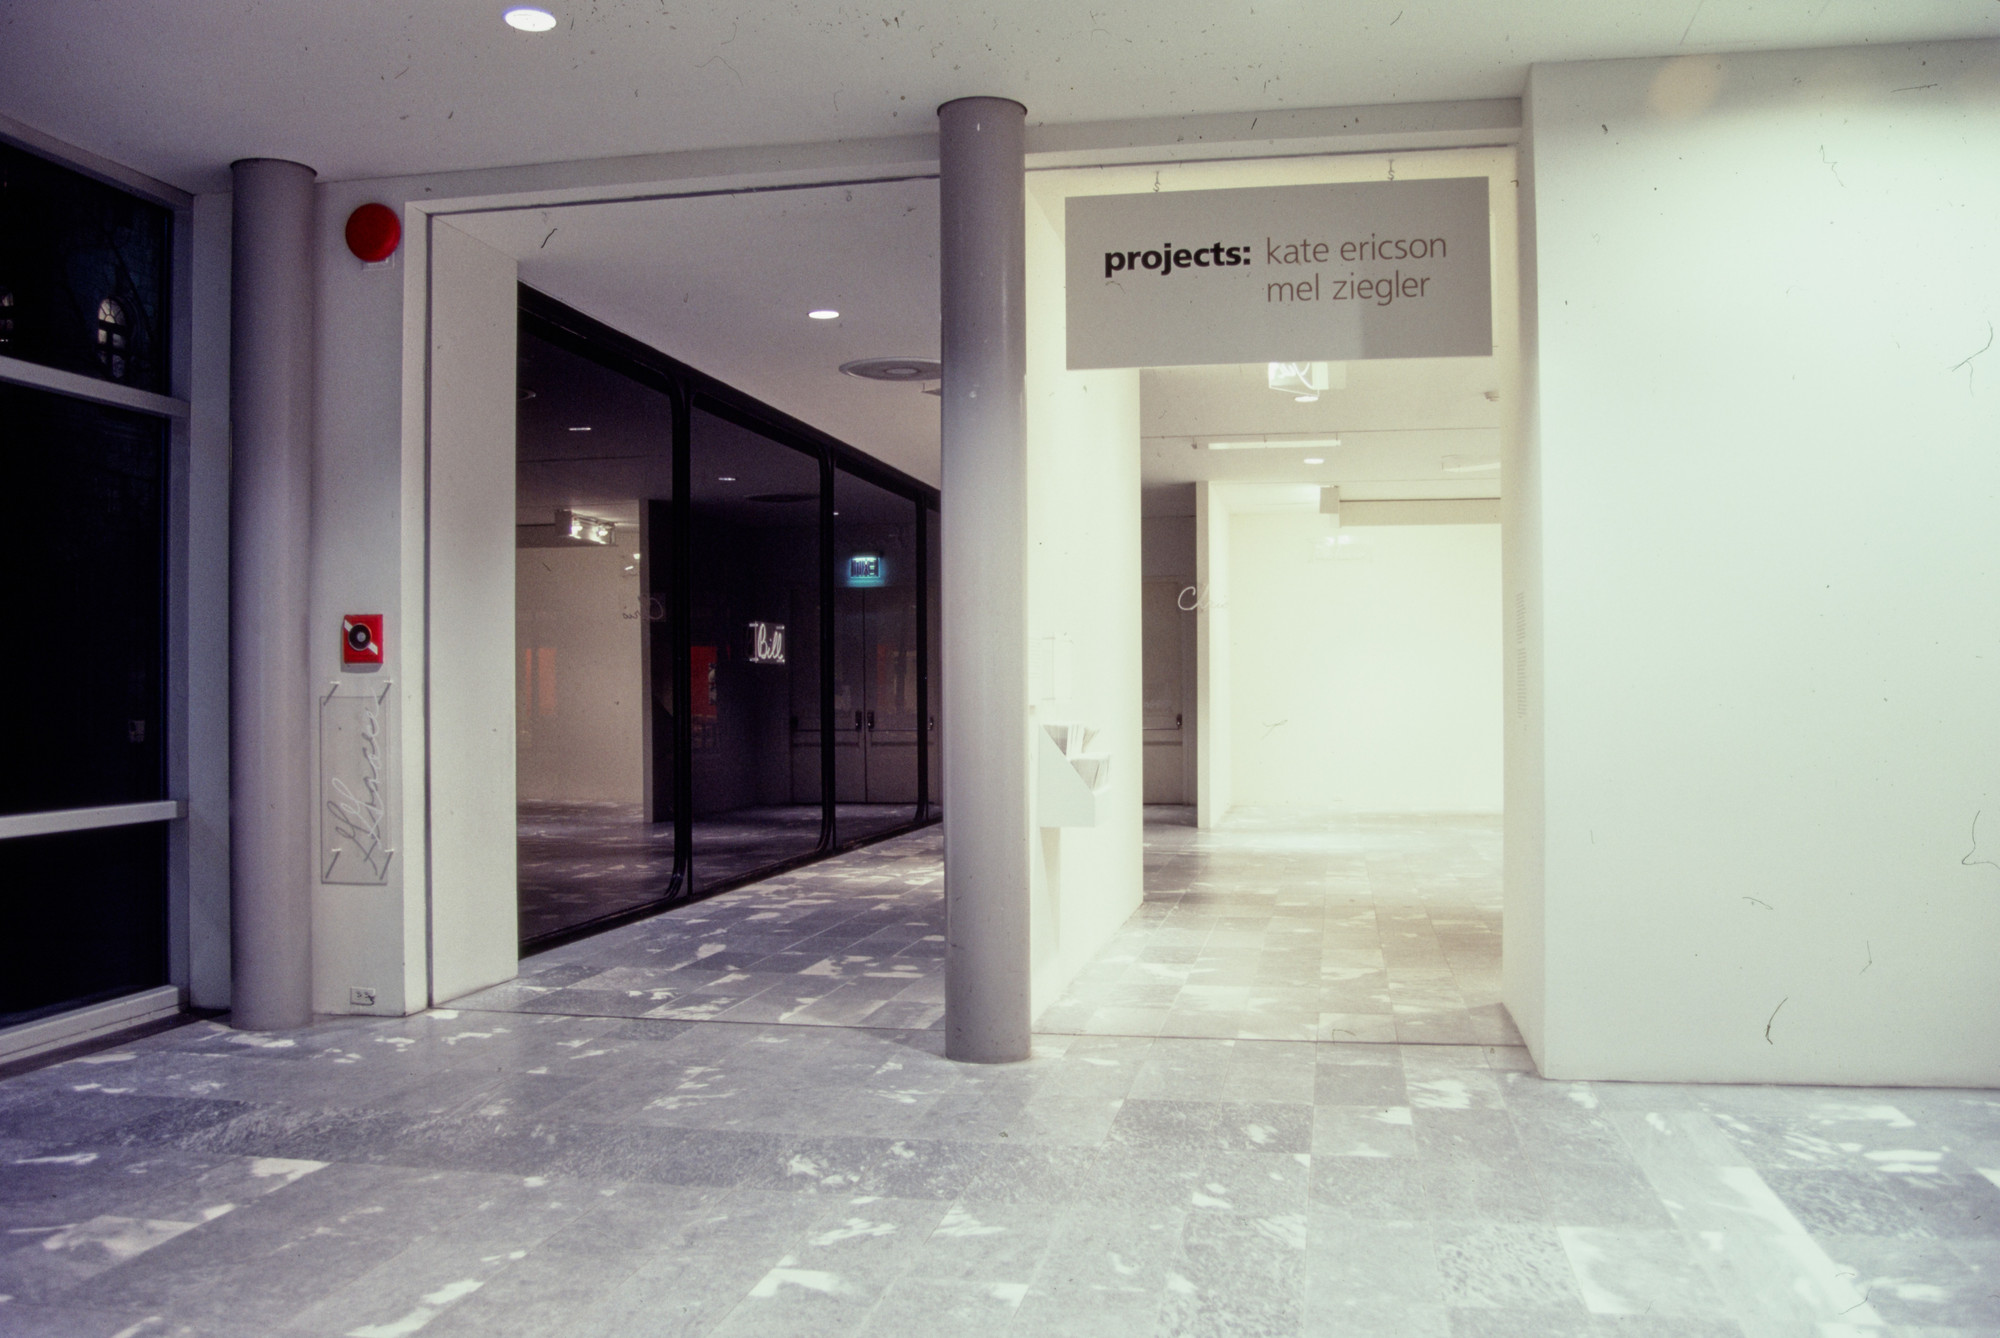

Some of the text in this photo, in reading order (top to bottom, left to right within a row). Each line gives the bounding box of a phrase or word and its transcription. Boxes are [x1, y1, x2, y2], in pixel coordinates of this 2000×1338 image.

[1105, 233, 1446, 278] projects: kate ericson
[1268, 270, 1430, 306] mel ziegler
[757, 623, 784, 660] Bill
